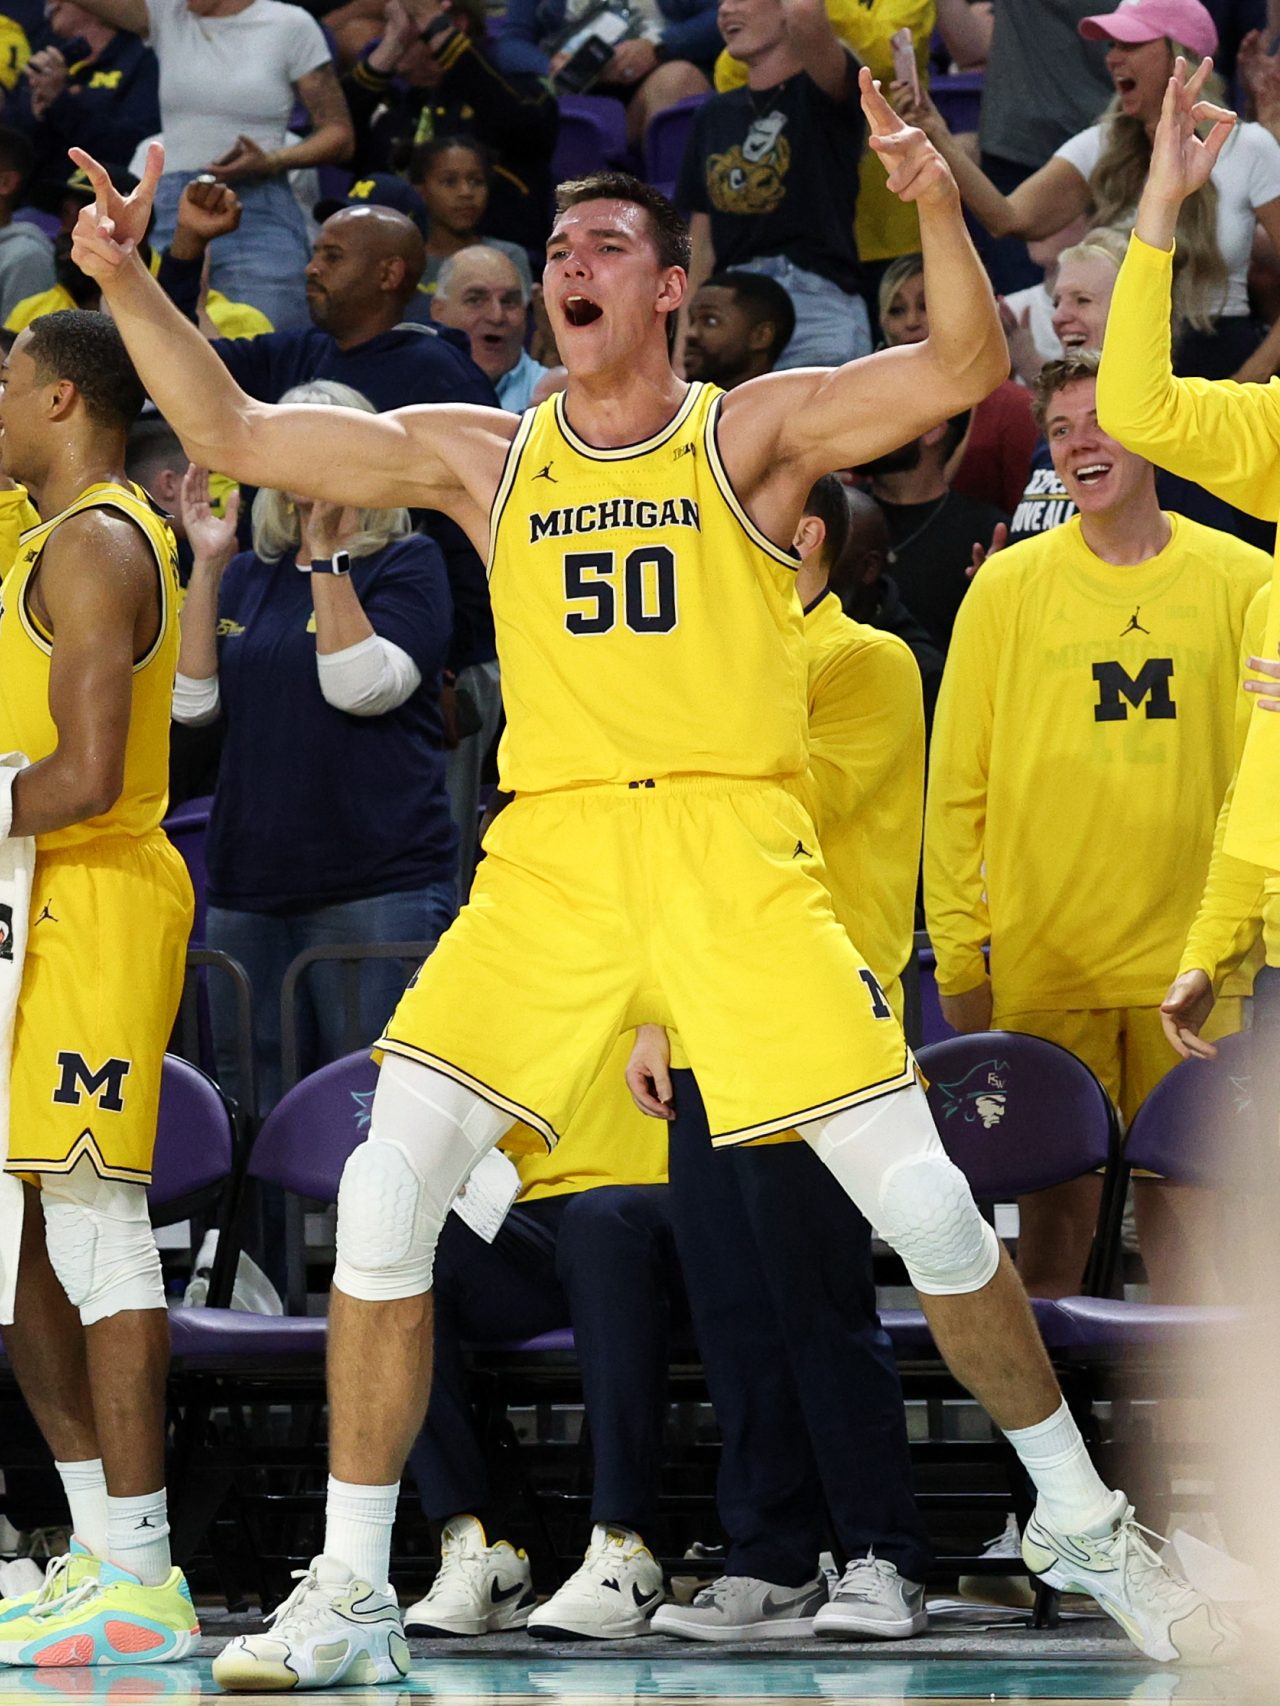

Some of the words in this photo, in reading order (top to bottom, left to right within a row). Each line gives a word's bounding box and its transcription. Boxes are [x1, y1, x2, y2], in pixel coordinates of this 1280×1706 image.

[529, 498, 702, 544] MICHIGAN
[564, 545, 677, 636] 50
[1091, 658, 1177, 722] M
[52, 1050, 131, 1113] M
